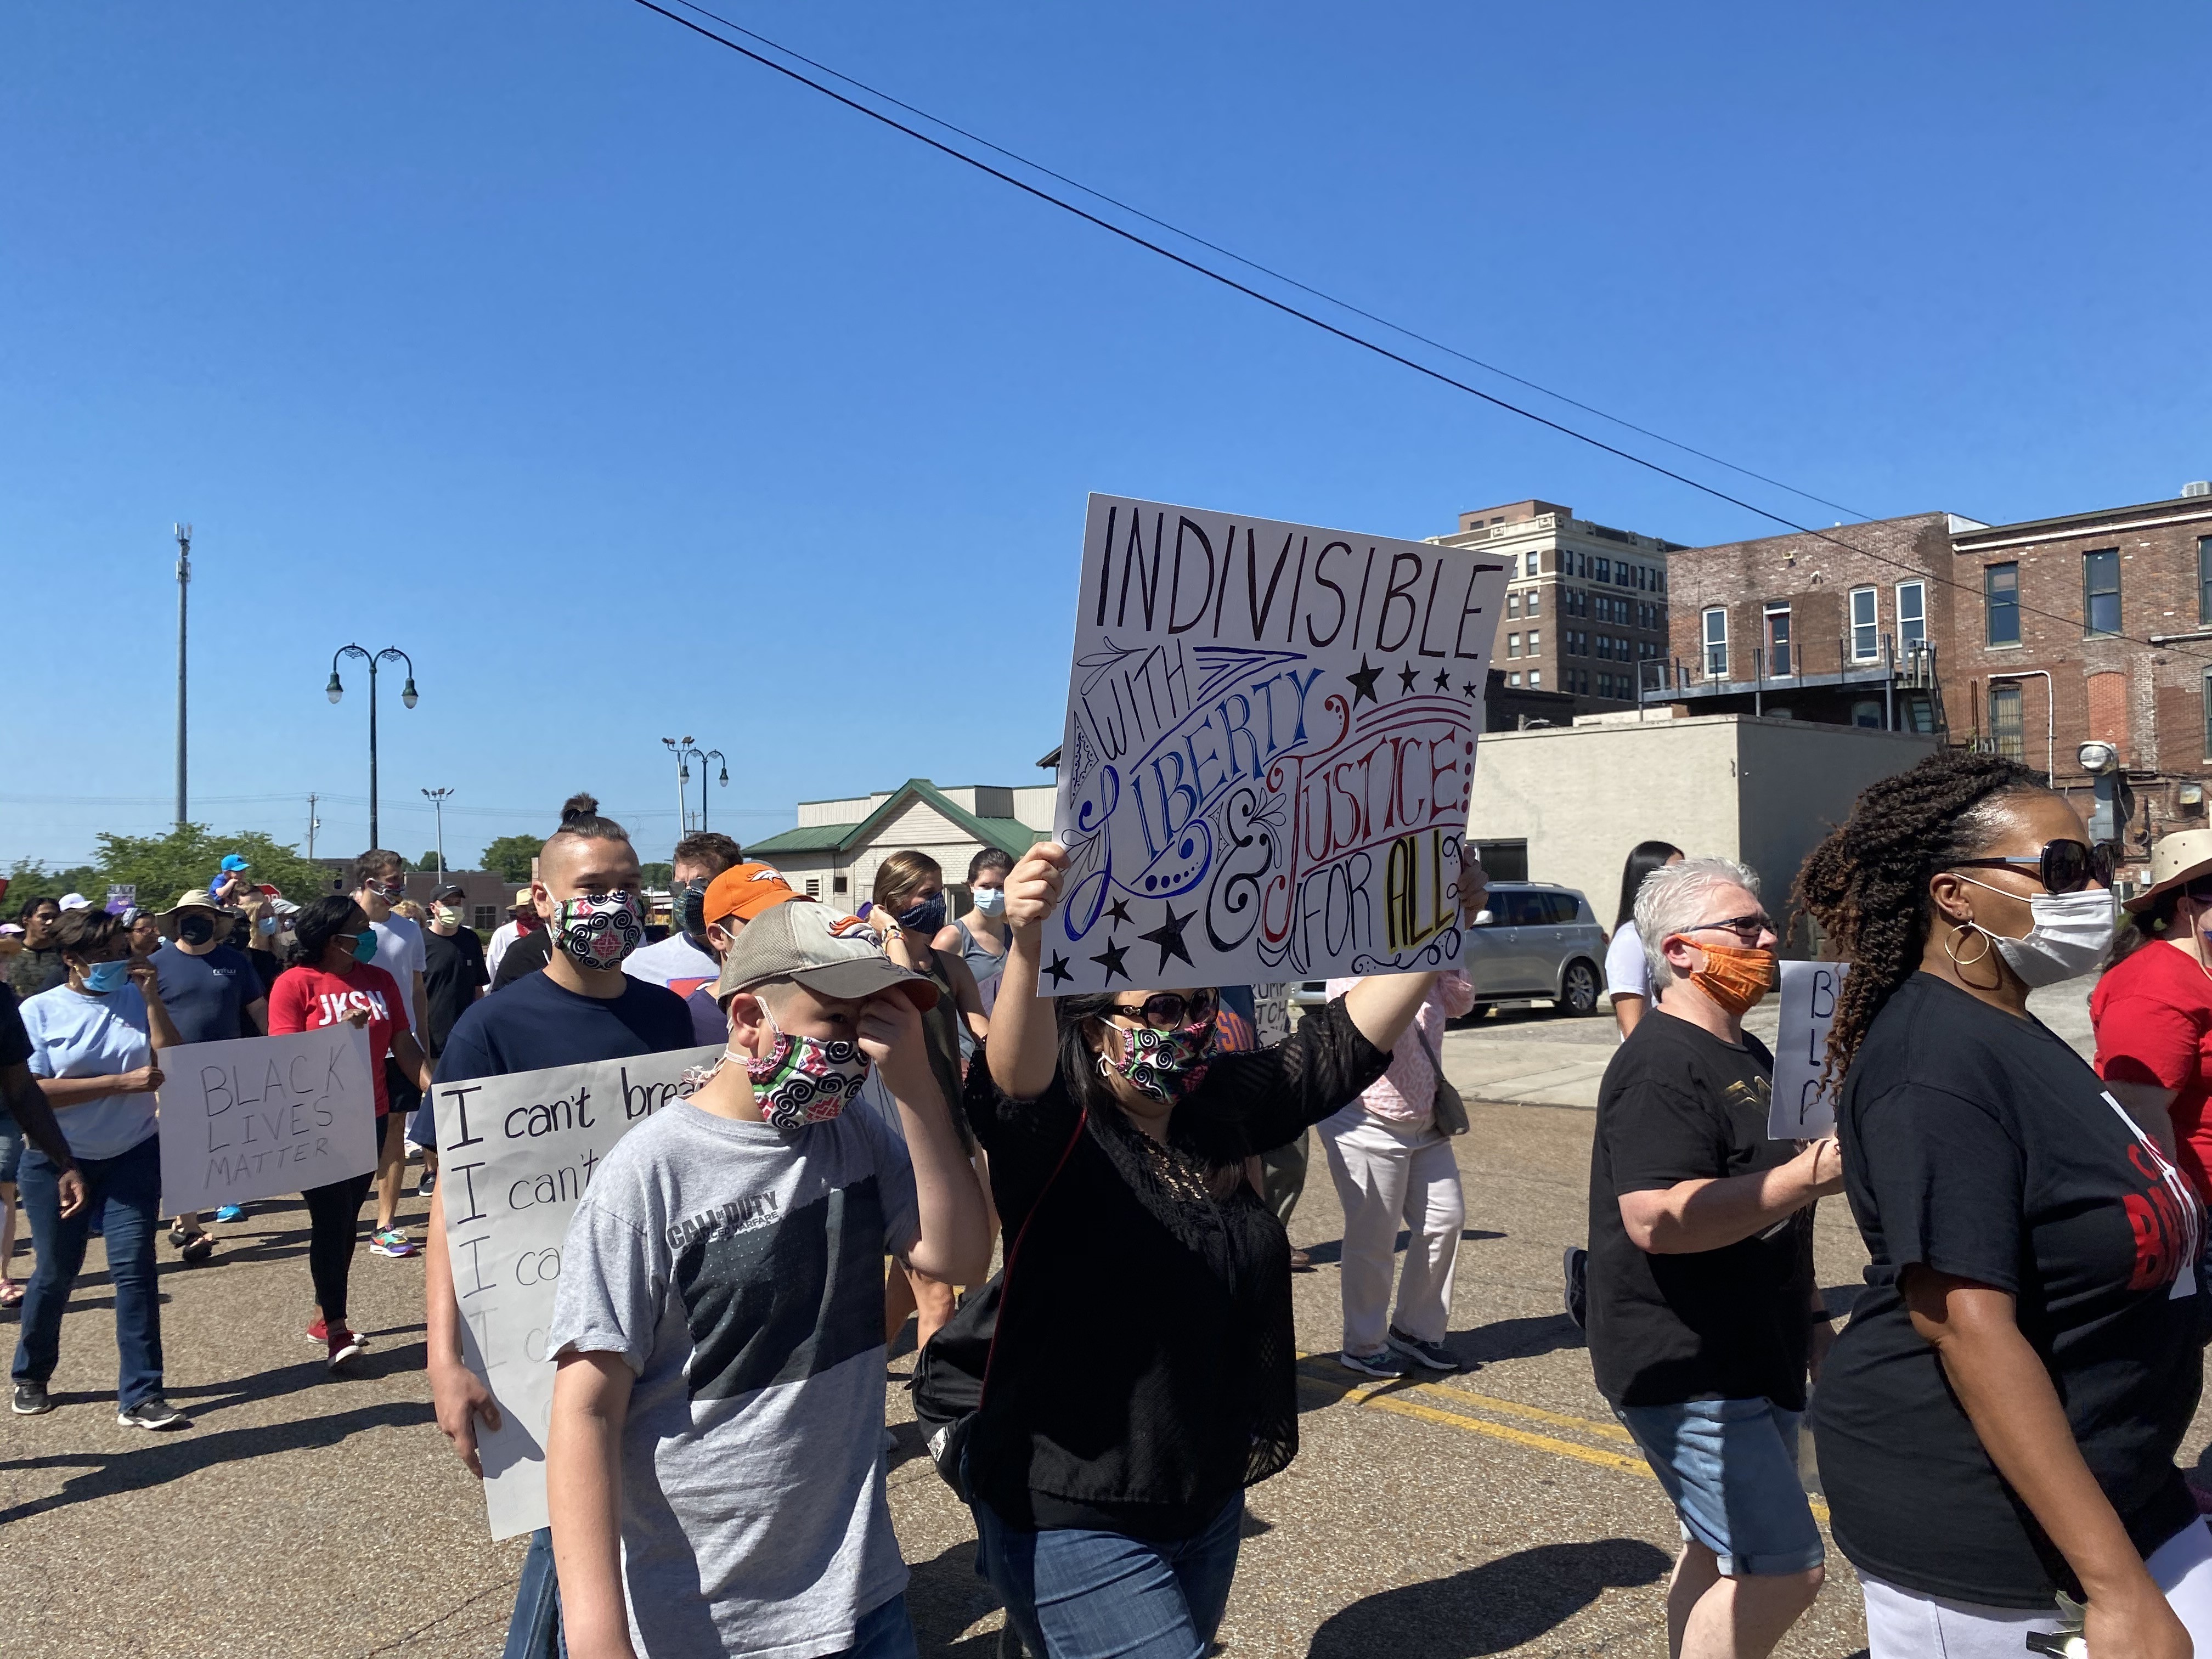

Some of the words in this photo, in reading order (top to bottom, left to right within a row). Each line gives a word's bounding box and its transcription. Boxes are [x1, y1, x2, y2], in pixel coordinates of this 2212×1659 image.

[1097, 506, 1503, 659] INDIVISIBLE
[1082, 639, 1190, 761] WITH
[1064, 668, 1325, 941] LIBERTY
[1263, 708, 1457, 943] JUSTICE
[1288, 852, 1372, 970] FOR
[1386, 829, 1457, 953] ALL
[319, 991, 389, 1025] JKSN
[201, 1043, 346, 1117] BLACK
[441, 1086, 484, 1151] I
[504, 1086, 595, 1139] can't
[620, 1058, 719, 1121] brea
[207, 1096, 333, 1153] LIVES
[202, 1137, 329, 1189] MATTER
[451, 1162, 487, 1224] I
[667, 1209, 723, 1250] CALL
[715, 1210, 725, 1220] OF
[722, 1190, 778, 1224] DUTY
[459, 1235, 497, 1299] I
